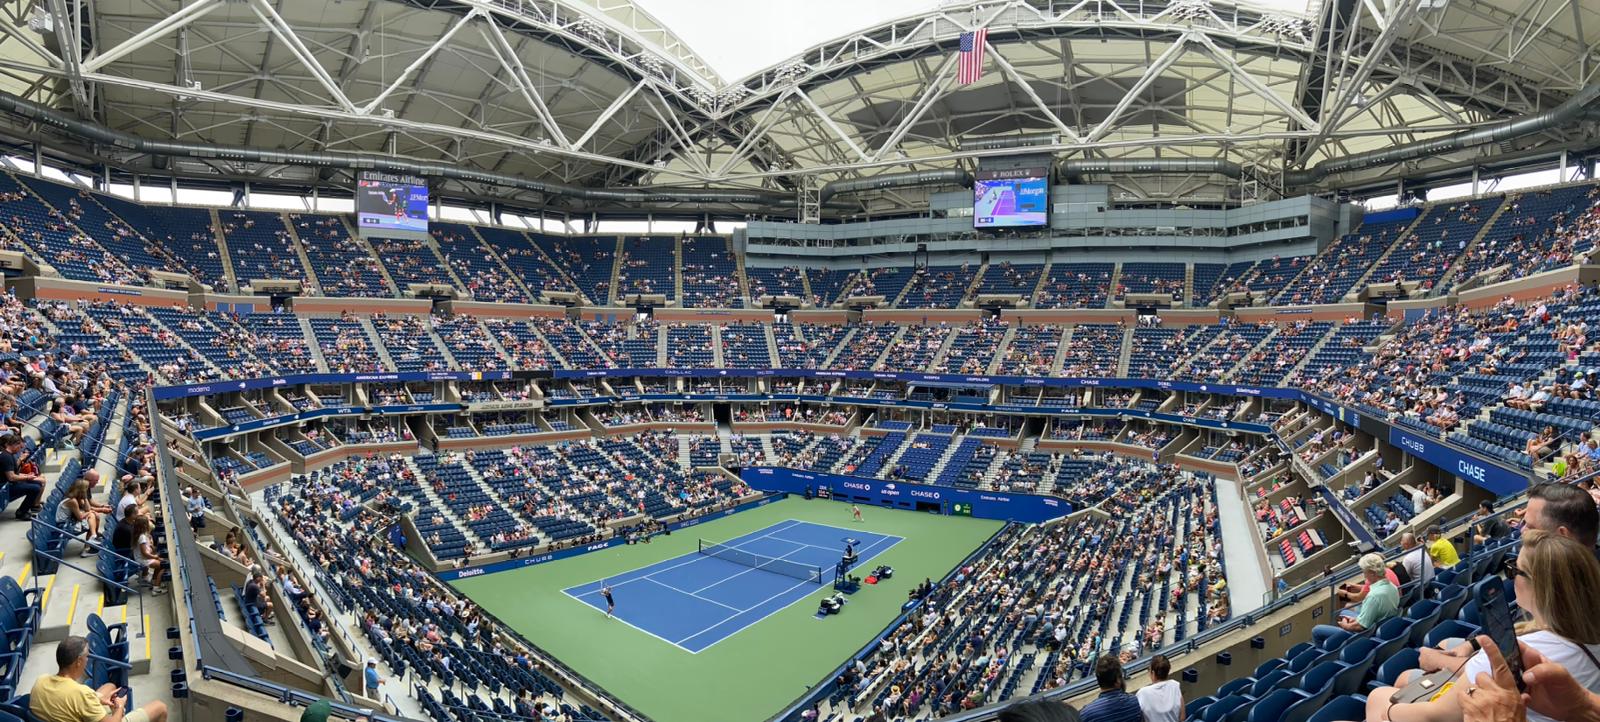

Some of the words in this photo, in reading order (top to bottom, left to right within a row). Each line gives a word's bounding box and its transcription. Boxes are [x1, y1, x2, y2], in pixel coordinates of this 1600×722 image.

[363, 171, 399, 183] Emirates
[400, 175, 425, 186] Airline
[187, 386, 211, 394] moderna
[1401, 436, 1425, 453] CHUBB
[1458, 460, 1486, 482] CHASE
[843, 482, 864, 490] CHASE
[910, 490, 933, 498] CHASE
[587, 542, 609, 551] FAGE
[524, 555, 553, 565] CHUBB
[458, 568, 485, 578] Deloitte.
